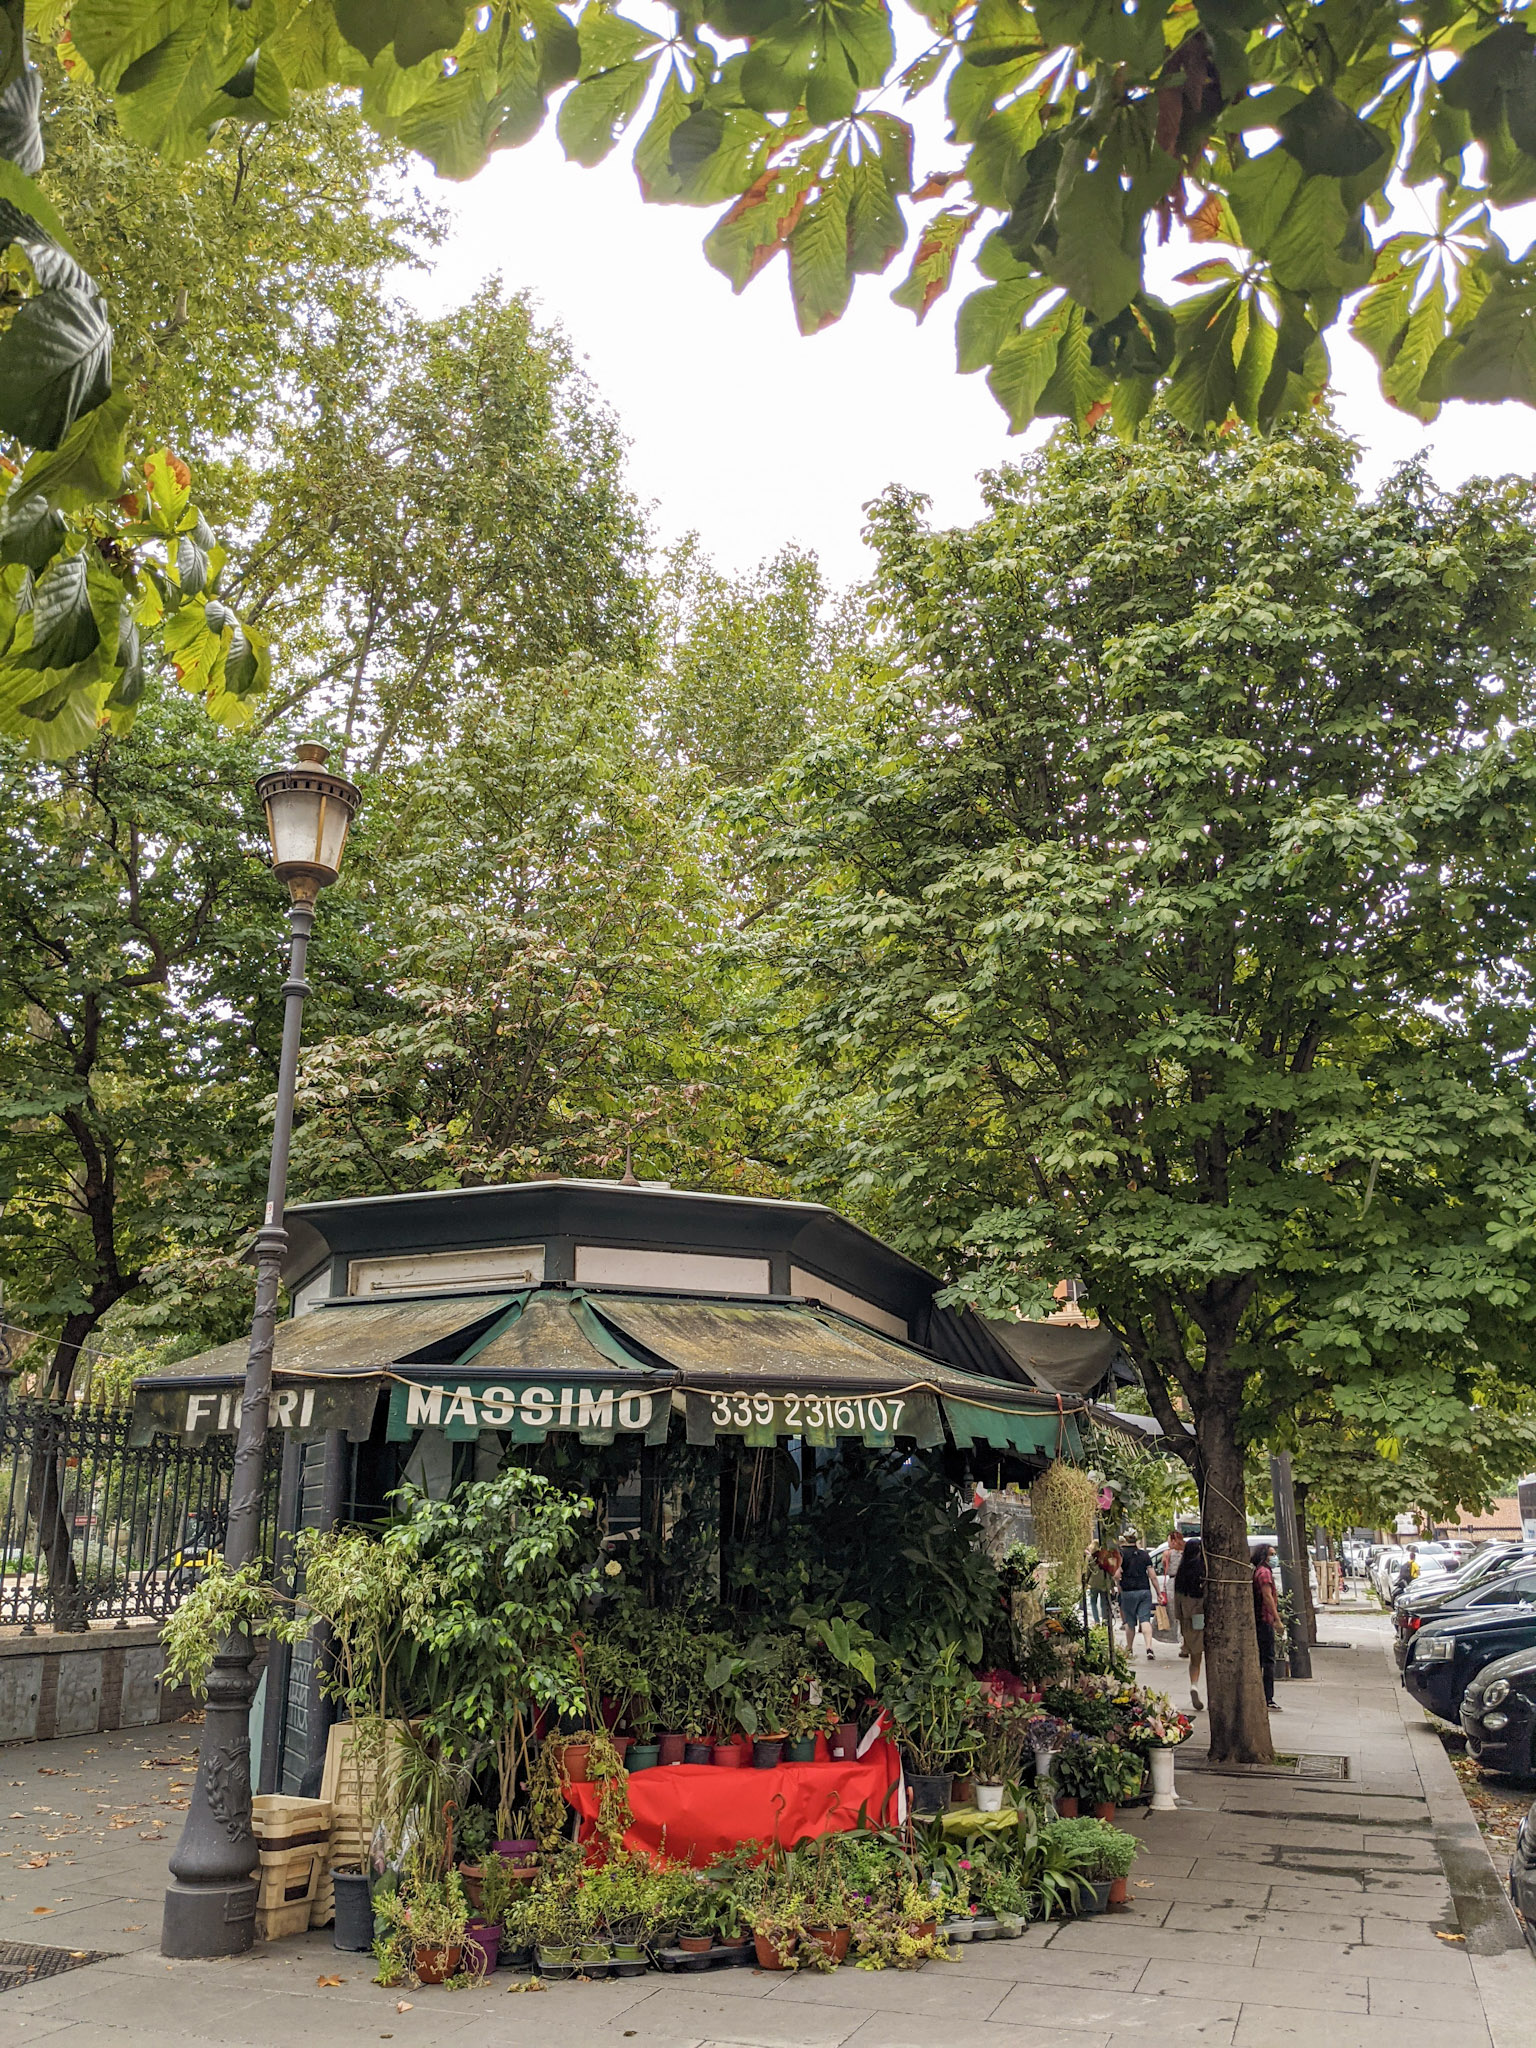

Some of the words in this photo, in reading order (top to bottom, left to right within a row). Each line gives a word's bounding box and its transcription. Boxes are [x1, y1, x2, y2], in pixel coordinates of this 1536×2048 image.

[185, 1388, 316, 1432] FIRI
[406, 1385, 653, 1429] MASSIMO
[710, 1390, 774, 1427] 339
[783, 1392, 906, 1432] 2316107
